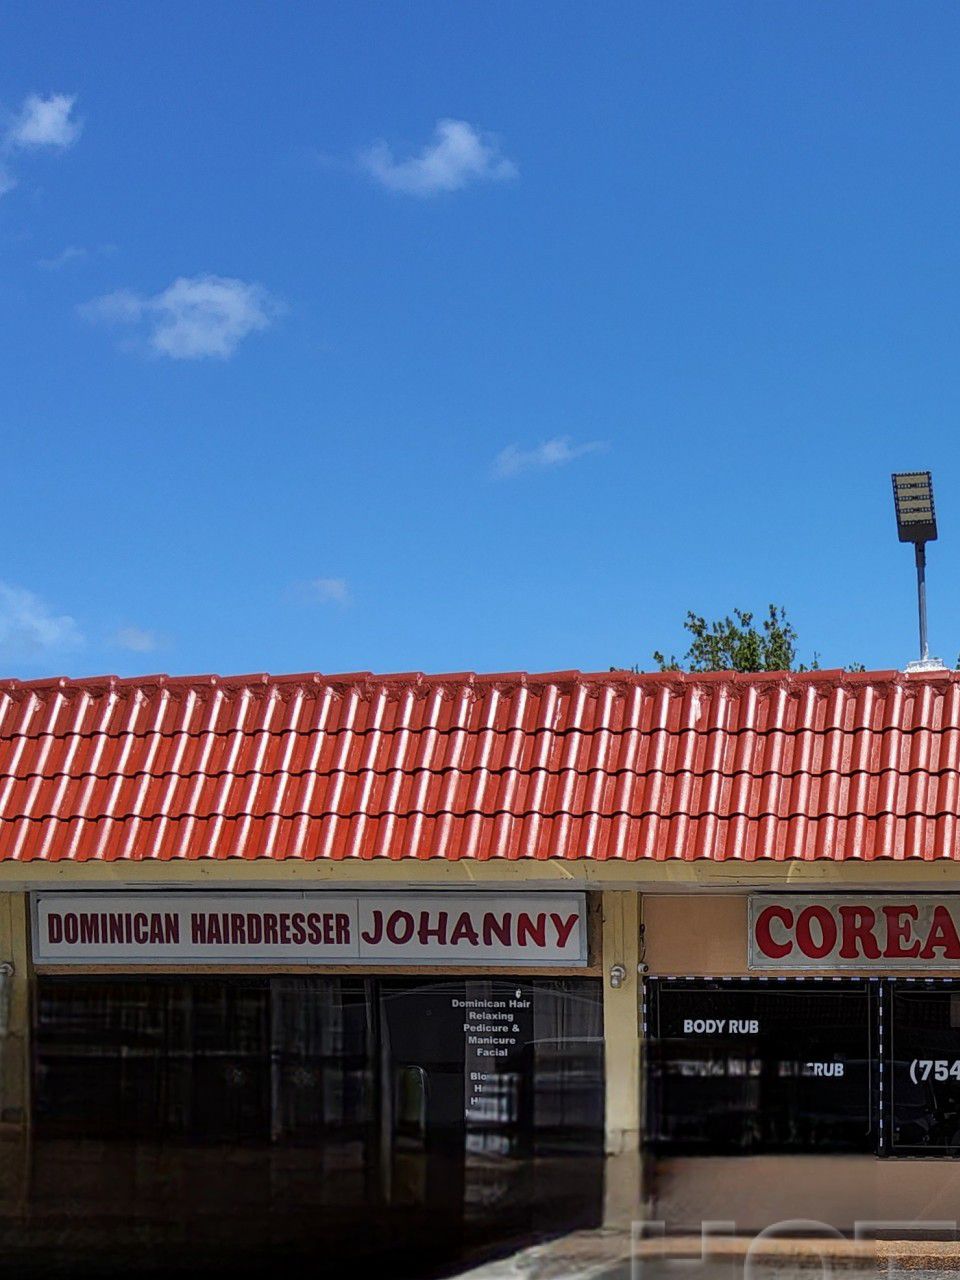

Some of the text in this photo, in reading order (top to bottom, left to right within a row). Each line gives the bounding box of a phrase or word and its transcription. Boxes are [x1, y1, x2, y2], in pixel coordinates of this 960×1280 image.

[47, 913, 351, 945] DOMINICAN HAIRDRESSER
[361, 909, 580, 948] JOHANNY
[451, 999, 531, 1008] Dominican Hair
[469, 1011, 514, 1022] Relaxing
[463, 1023, 520, 1032] Pedicure &
[683, 1019, 759, 1034] BODY RUB
[468, 1036, 516, 1044] Manicure
[476, 1048, 508, 1056] Facial
